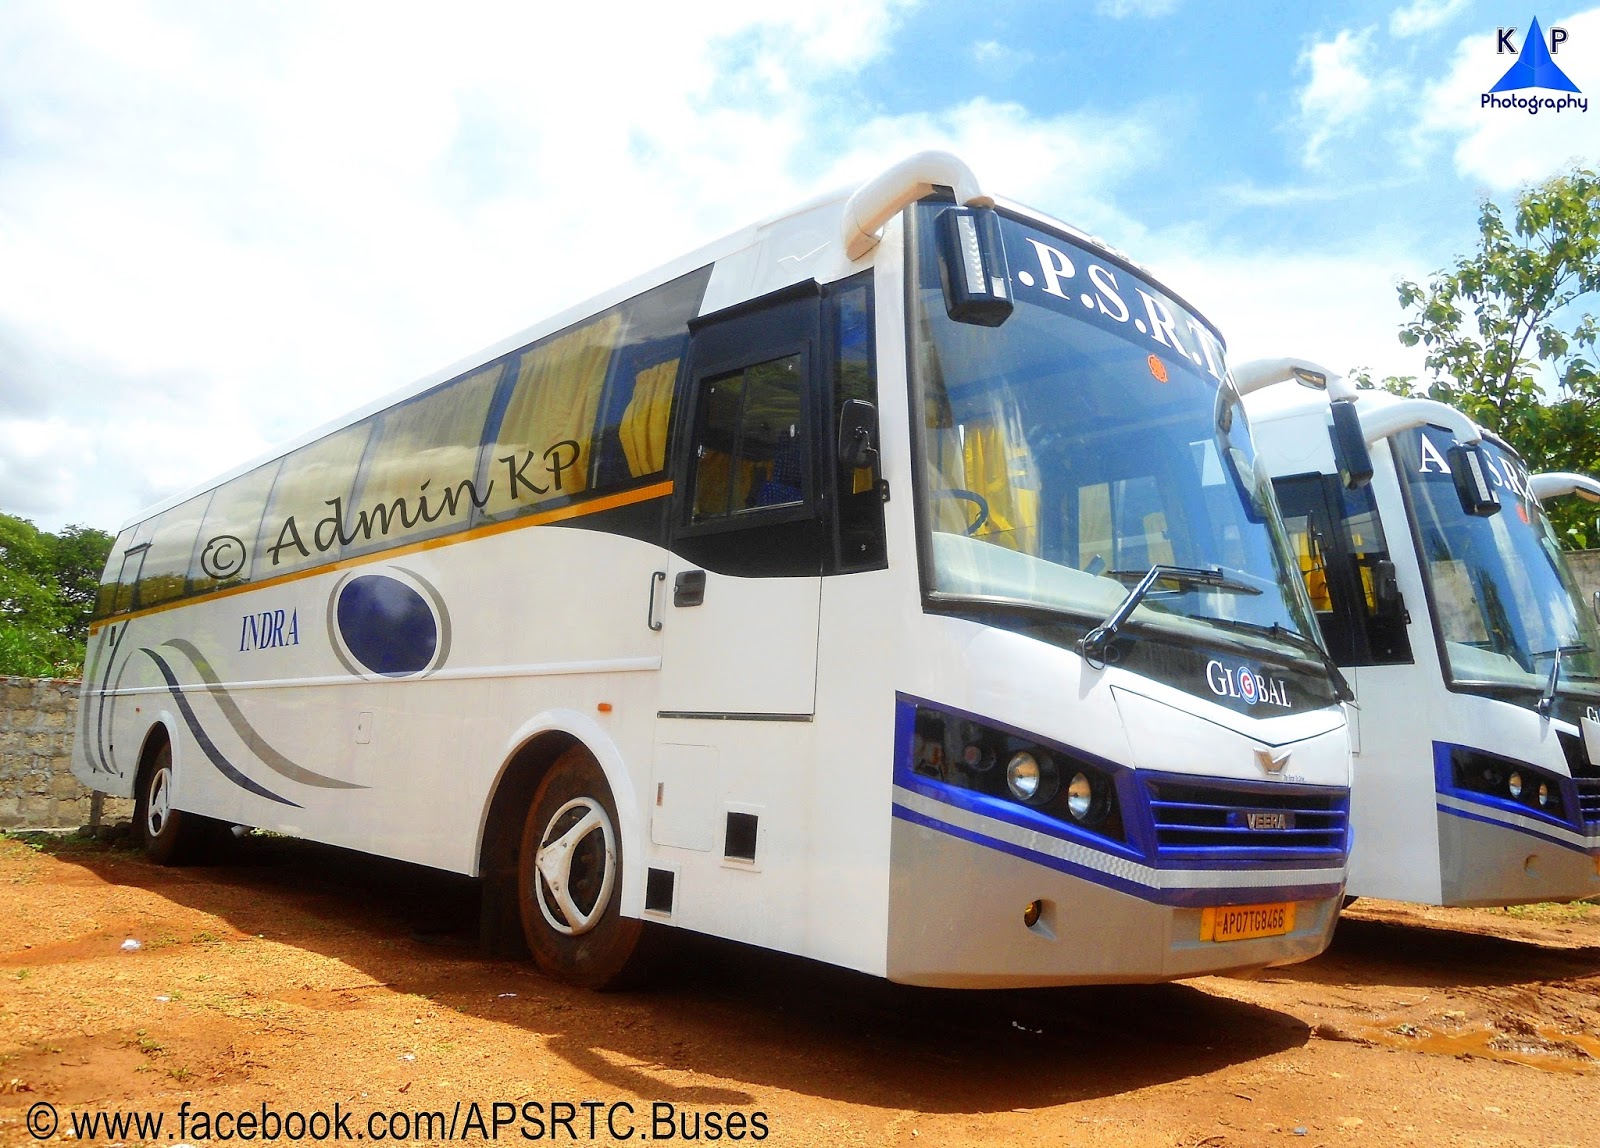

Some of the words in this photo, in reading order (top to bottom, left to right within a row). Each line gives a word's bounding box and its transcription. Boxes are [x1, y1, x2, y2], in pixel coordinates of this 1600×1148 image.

[238, 606, 300, 652] INDRA
[1246, 813, 1287, 831] VEERA
[1222, 908, 1284, 935] AP07TG8466
